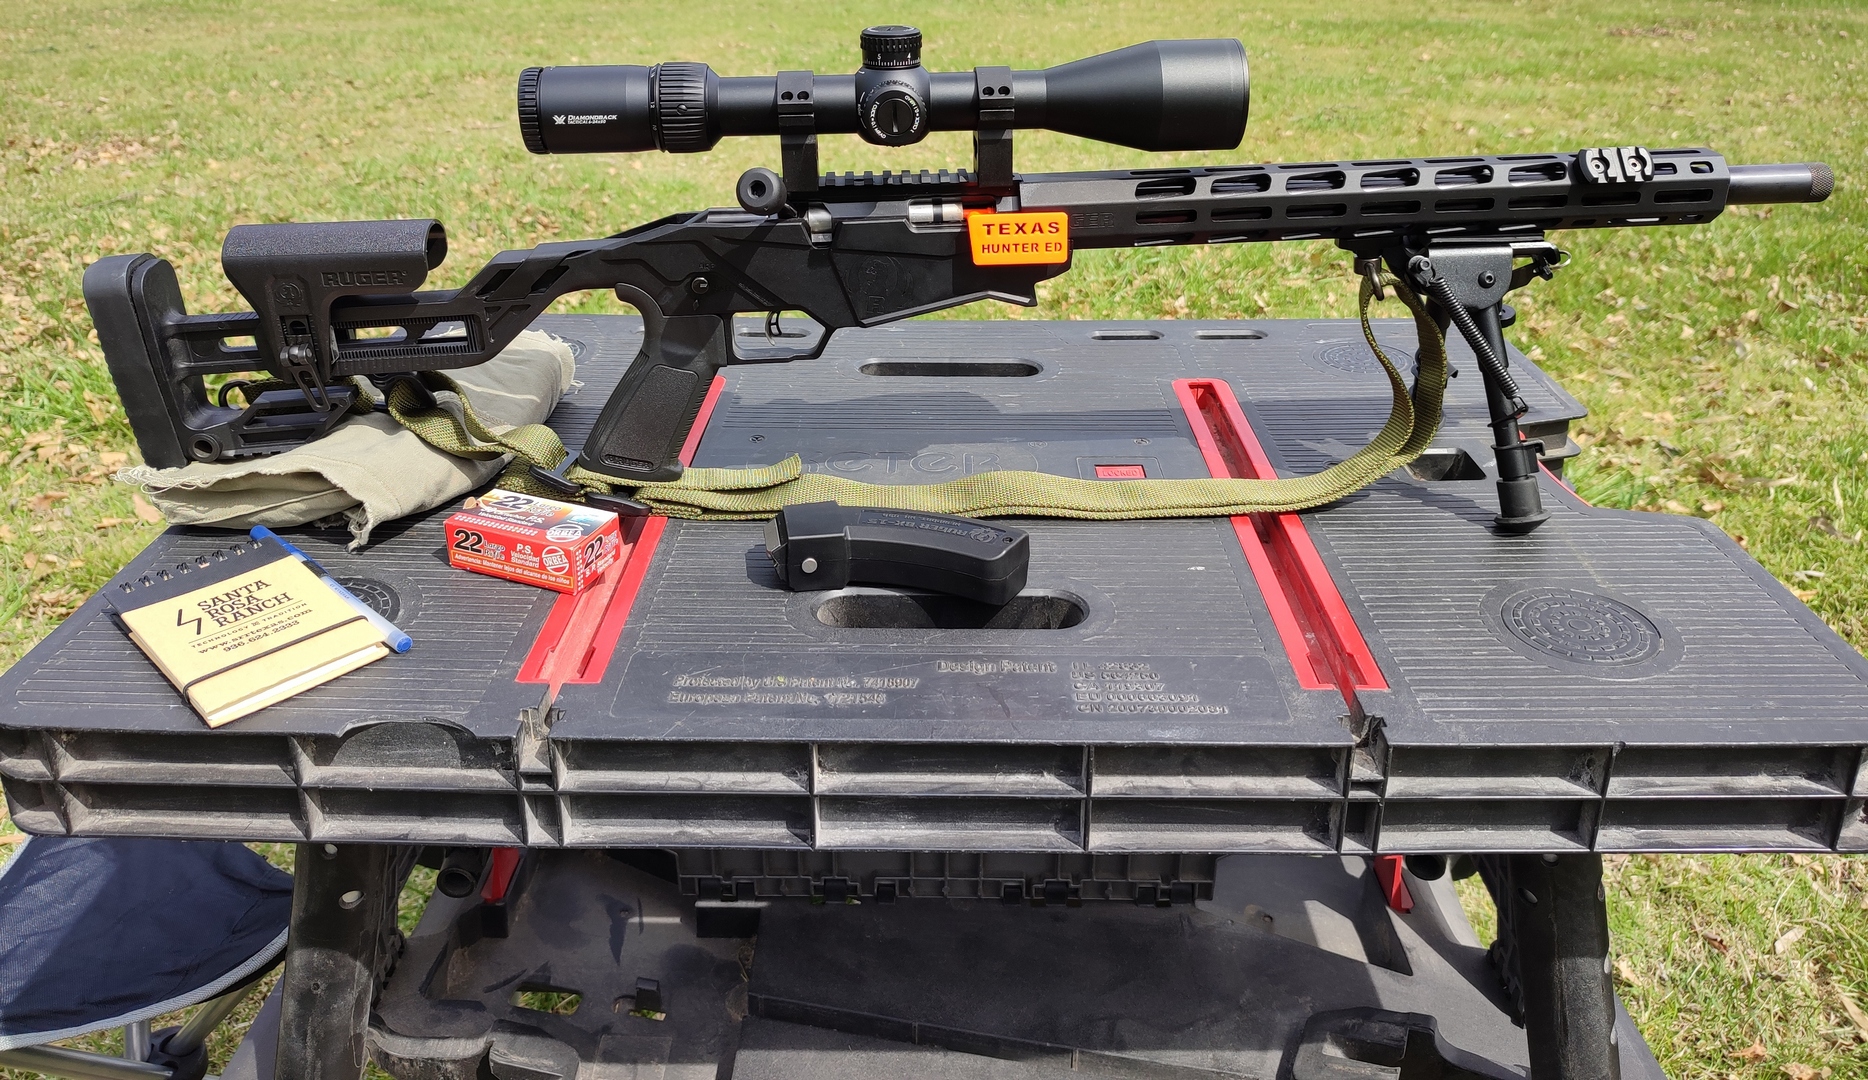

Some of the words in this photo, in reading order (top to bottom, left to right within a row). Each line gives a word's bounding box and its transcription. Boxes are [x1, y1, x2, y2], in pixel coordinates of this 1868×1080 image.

[982, 221, 1060, 235] TEXAS
[1069, 212, 1115, 230] GER
[981, 242, 1039, 254] HUNTER
[1045, 242, 1063, 253] ED
[321, 270, 404, 288] RUGER
[492, 495, 534, 509] 22
[546, 529, 582, 537] ORBEA
[919, 523, 968, 537] RUGER
[452, 528, 483, 555] 22
[484, 540, 506, 552] Largo
[516, 543, 534, 555] P.S.
[583, 535, 604, 571] 22
[510, 550, 540, 563] Velocidad
[510, 556, 540, 569] Standard
[542, 553, 569, 567] ORBEA
[197, 580, 272, 611] SANTA
[204, 594, 263, 620] ROSA
[213, 592, 294, 627] RANCH
[191, 626, 249, 648] TECHNOLOGY
[262, 602, 308, 622] TRADITION
[198, 608, 314, 654] www.srrtexas.com
[223, 620, 300, 652] 936.624.2333
[937, 660, 997, 676] Design
[1000, 660, 1058, 674] Patent
[1073, 682, 1101, 692] CA
[1074, 692, 1103, 703] EU
[1076, 703, 1104, 714] CN
